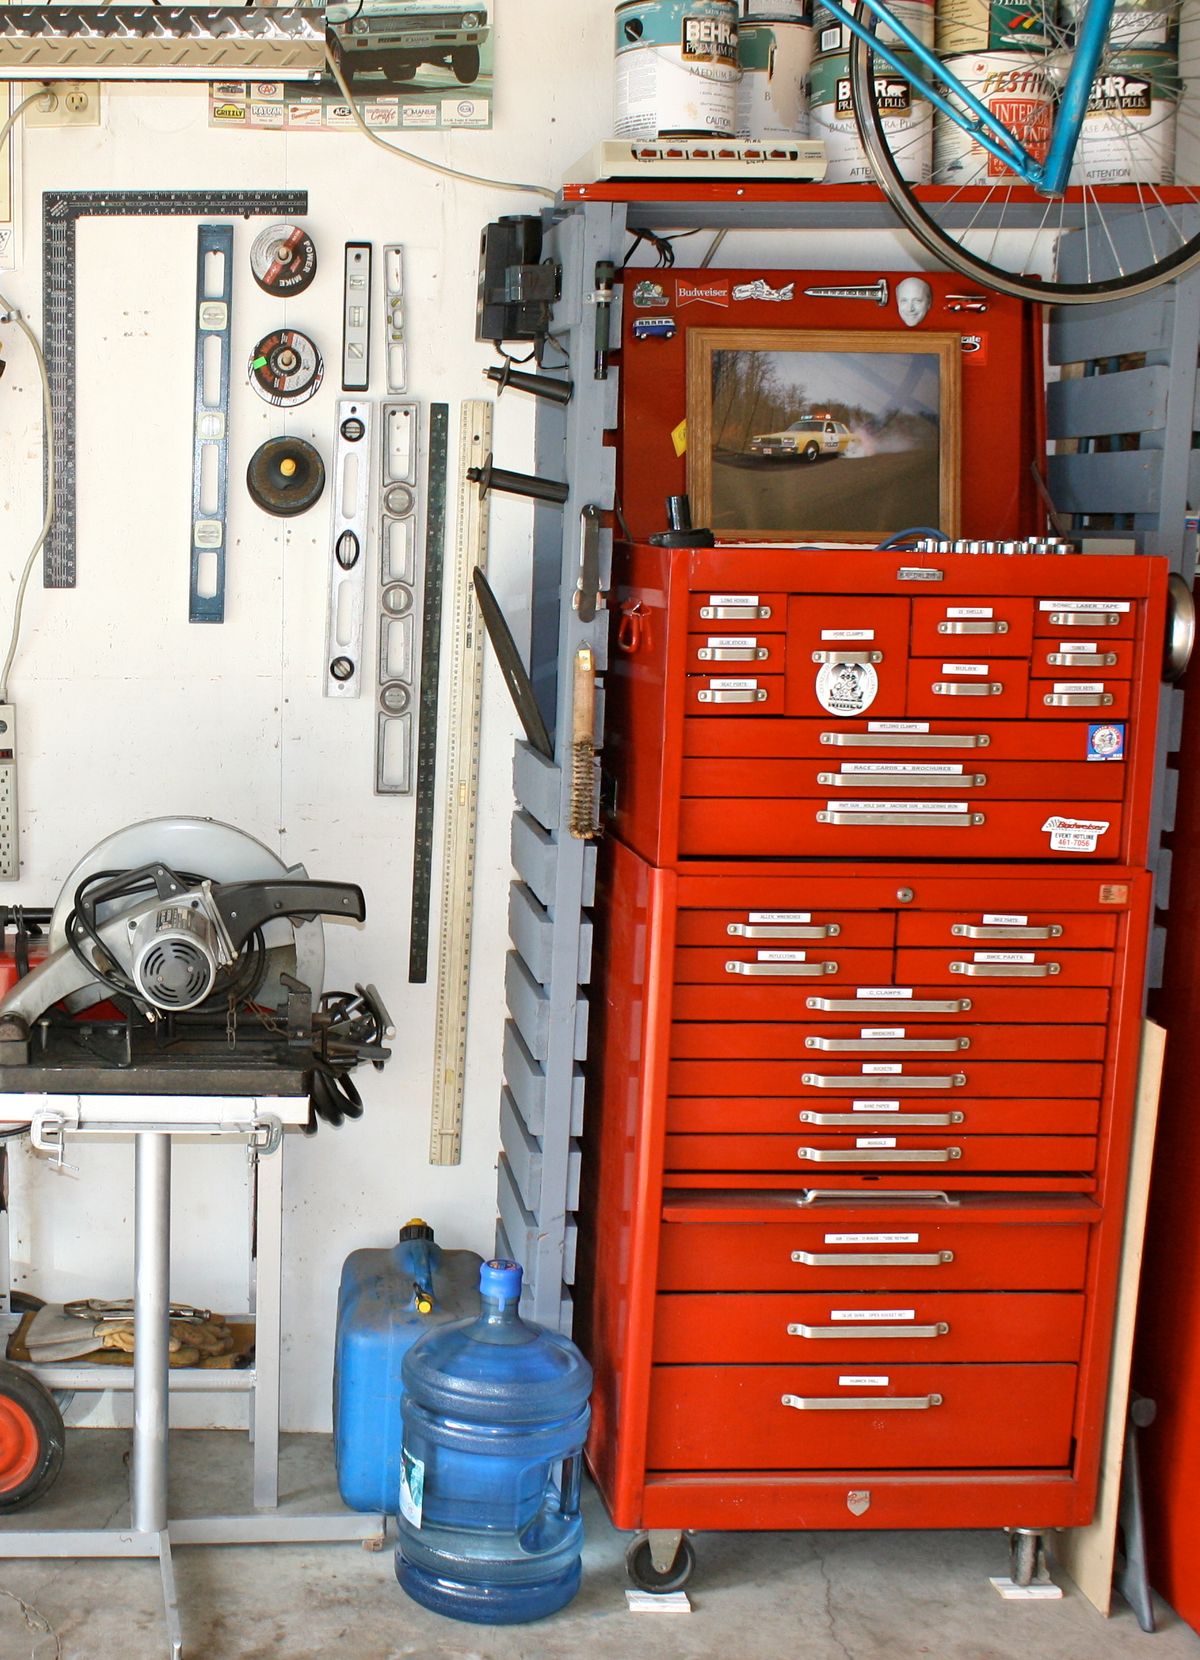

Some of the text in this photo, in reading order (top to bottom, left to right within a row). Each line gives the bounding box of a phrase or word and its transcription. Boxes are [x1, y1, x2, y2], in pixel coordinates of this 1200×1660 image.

[686, 19, 731, 42] BEHR
[689, 67, 727, 79] MEDIUM
[839, 80, 887, 100] BR
[884, 98, 907, 108] PLUS
[1123, 98, 1147, 108] PLUS
[335, 108, 350, 116] ACE
[705, 115, 732, 127] CAUTION
[1084, 124, 1102, 132] ASE
[1087, 169, 1131, 180] ATTENTION
[279, 240, 314, 286] POWER MIKE
[679, 288, 727, 297] Budweiser
[1057, 820, 1106, 831] Budweiser
